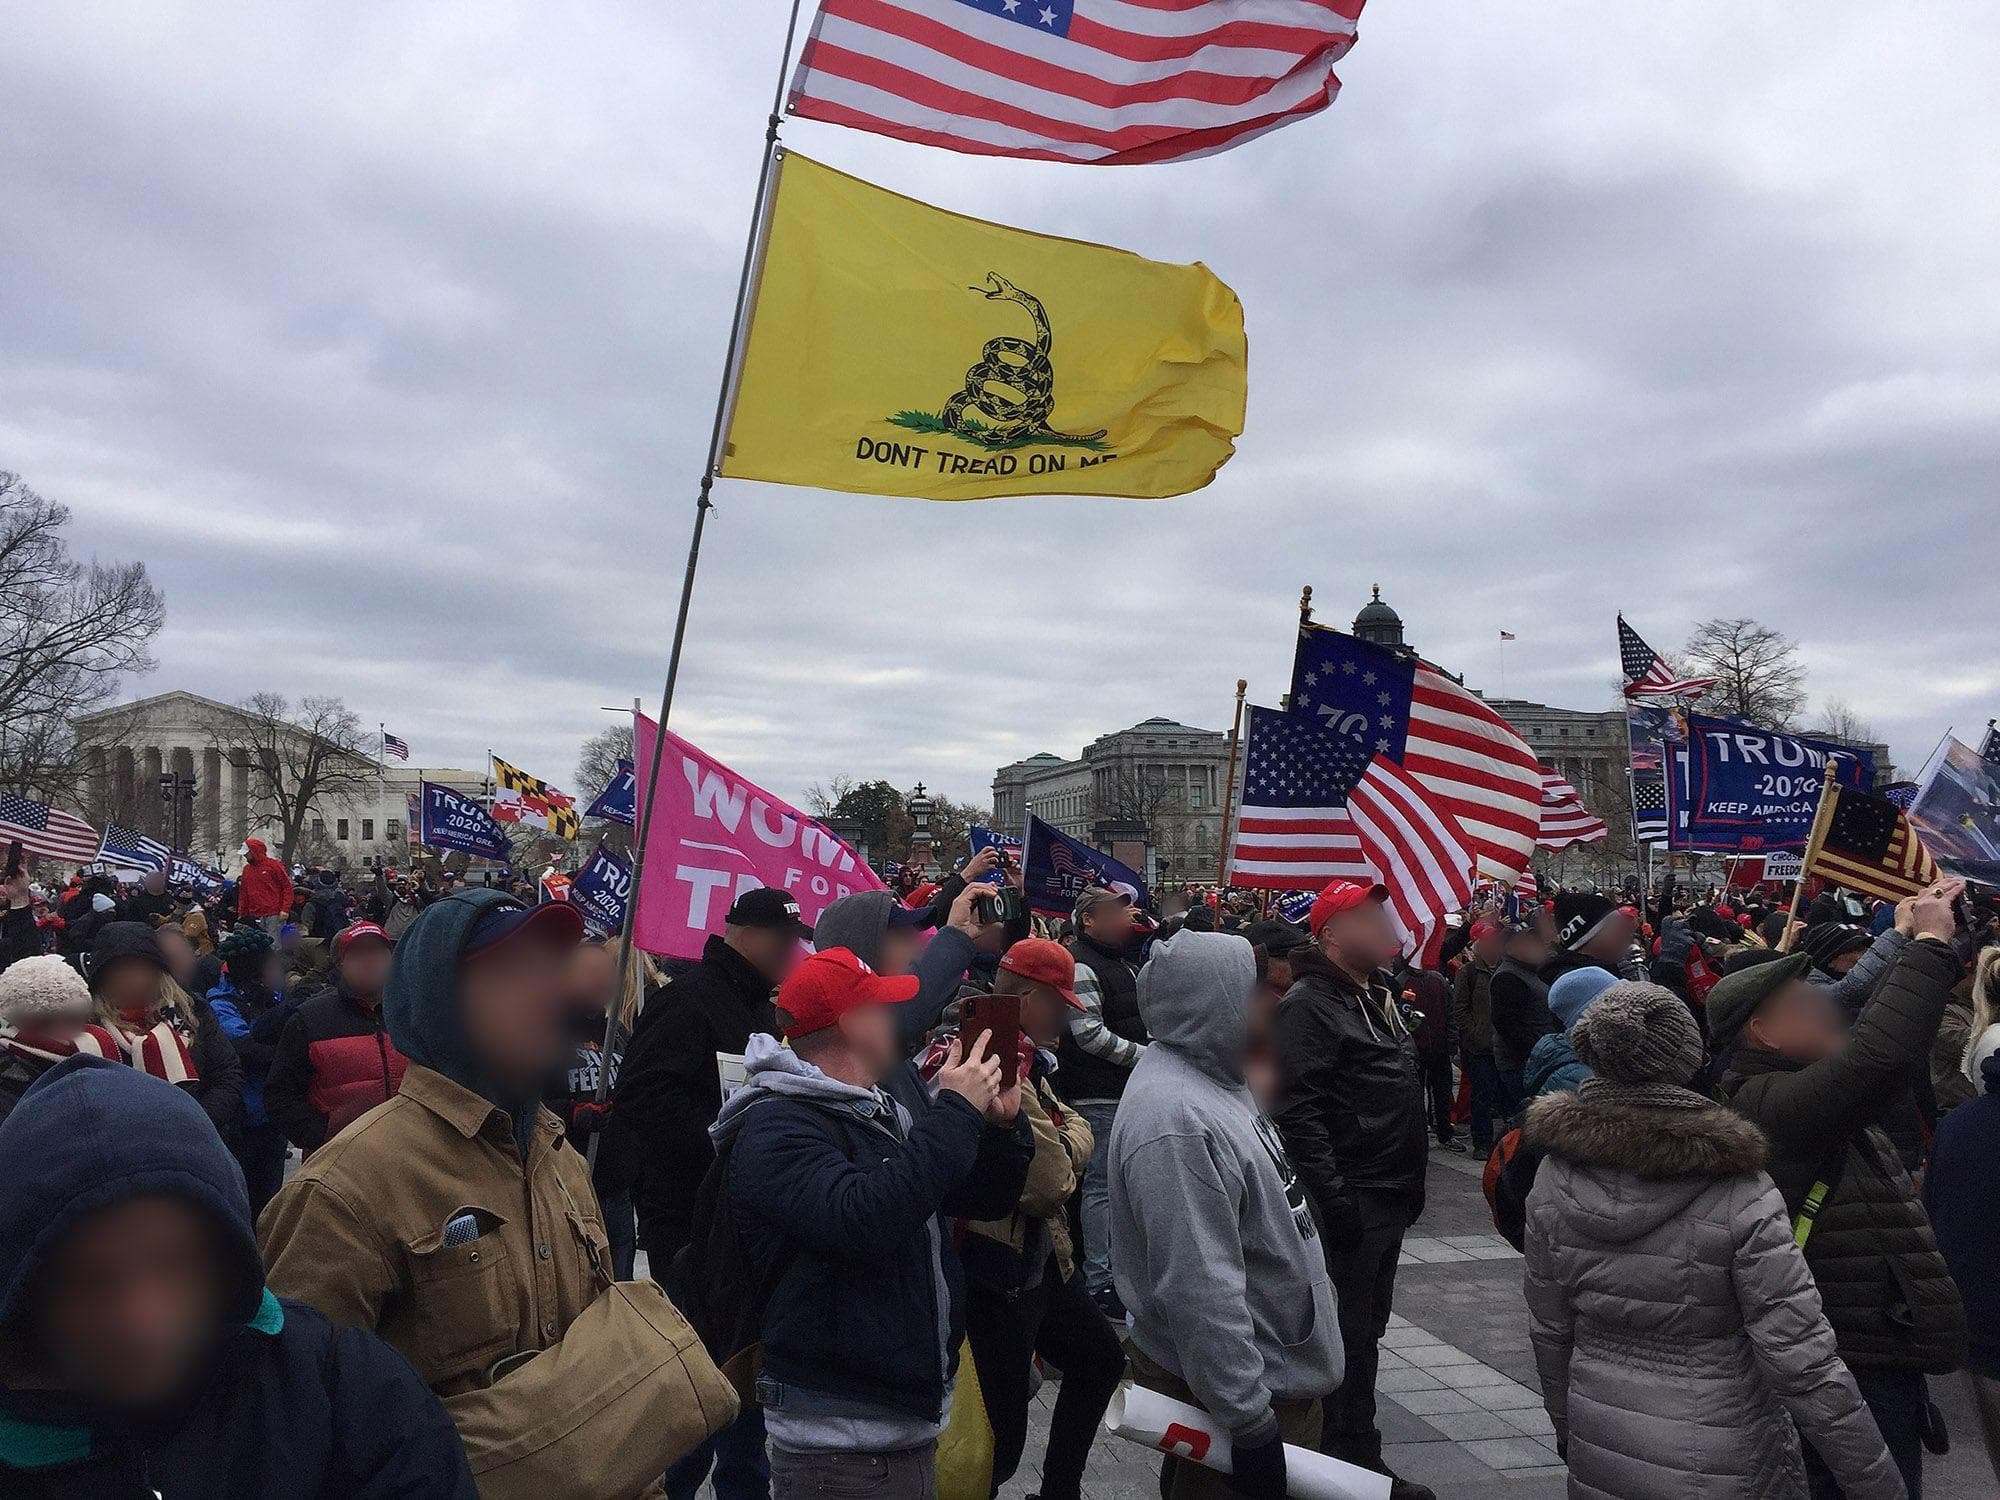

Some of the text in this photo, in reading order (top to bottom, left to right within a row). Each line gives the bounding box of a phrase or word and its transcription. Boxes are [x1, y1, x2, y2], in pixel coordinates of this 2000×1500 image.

[856, 436, 928, 469] DONT
[936, 451, 1017, 475] TREAD
[1029, 454, 1066, 474] ON
[431, 789, 503, 841] TRUM
[682, 756, 863, 877] WOM
[1708, 801, 1749, 814] KEEP
[1751, 801, 1813, 816] AMICA
[593, 856, 632, 903] TRU
[1061, 872, 1095, 892] TEX
[1767, 864, 1803, 876] FREEDO
[1560, 914, 1587, 941] on
